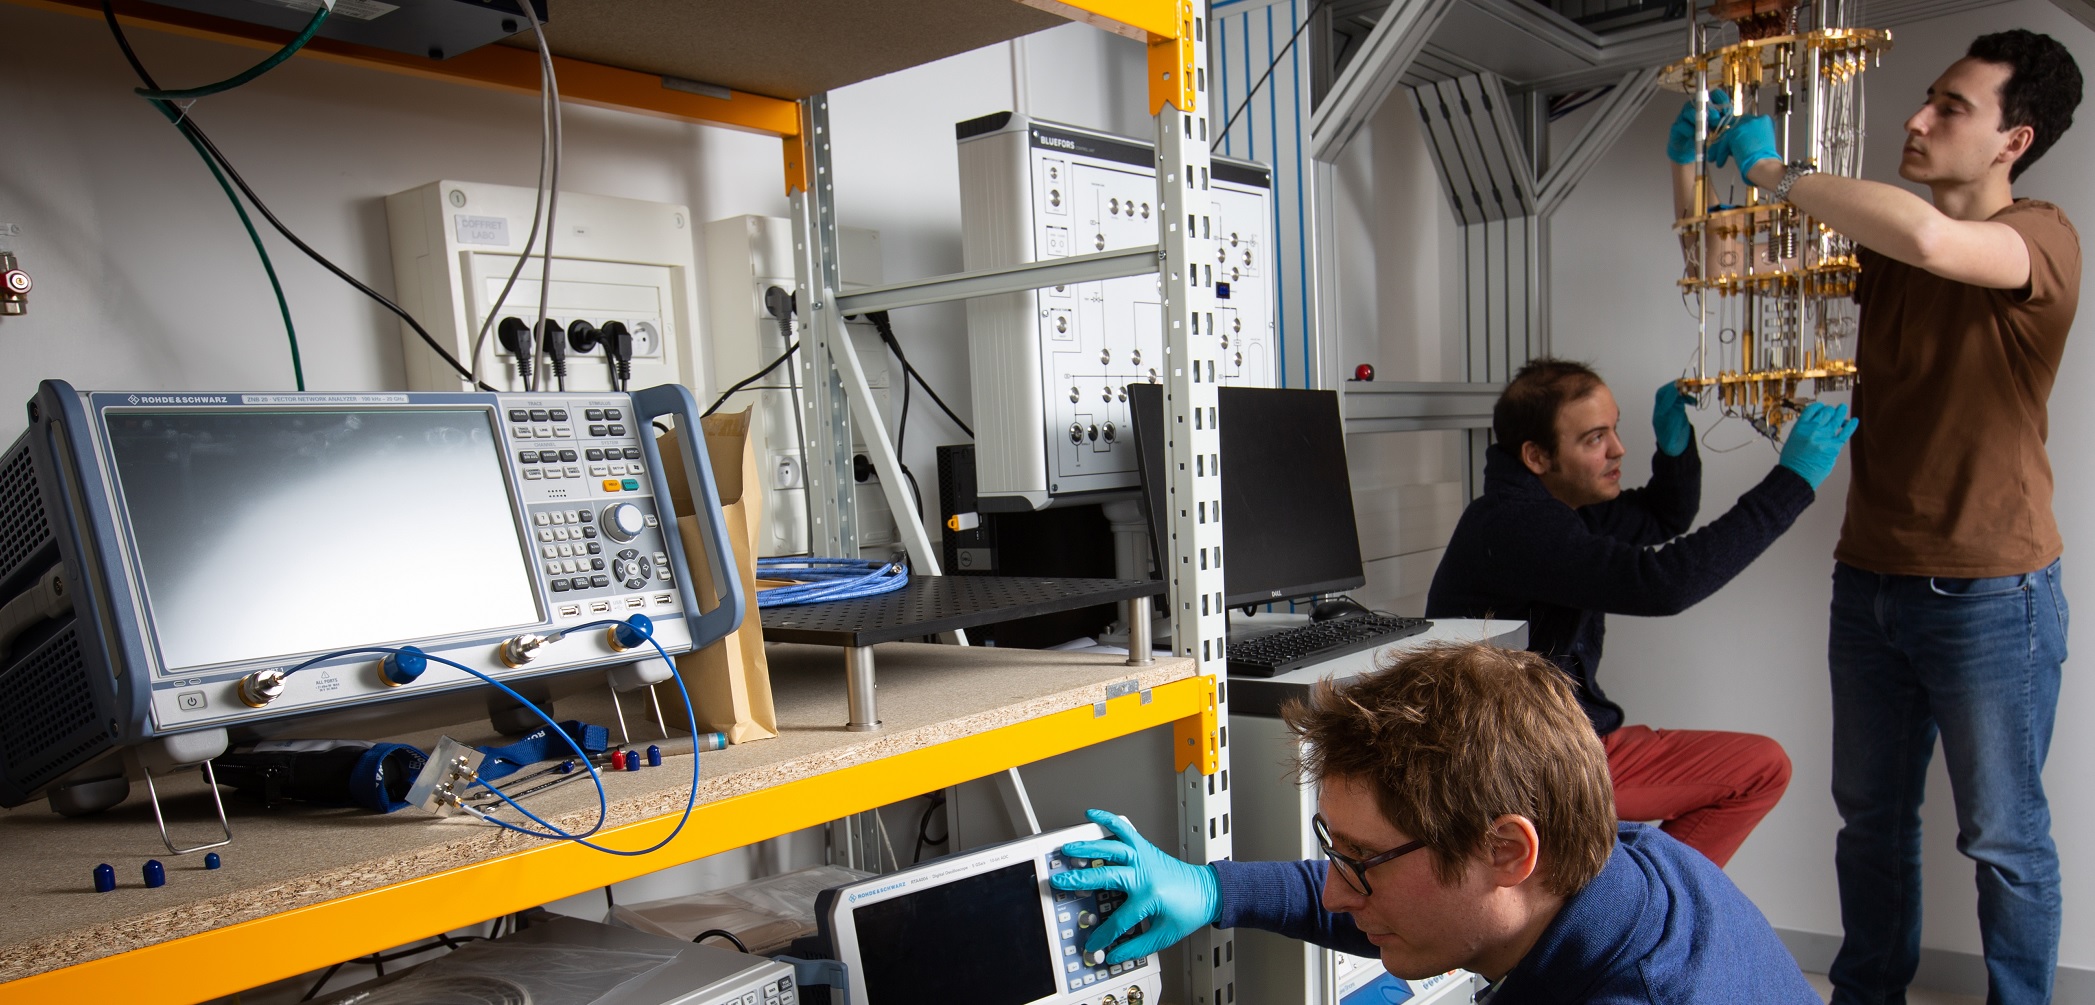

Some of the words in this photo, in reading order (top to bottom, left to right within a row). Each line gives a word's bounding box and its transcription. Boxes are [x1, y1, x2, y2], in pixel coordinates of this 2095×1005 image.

[1040, 135, 1075, 149] BLUEFORS
[462, 219, 502, 230] COFFRET
[471, 230, 495, 240] LABO
[141, 396, 228, 404] ROHDE&SCHWARZ
[857, 881, 906, 899] ROHDE&SCHWARZ
